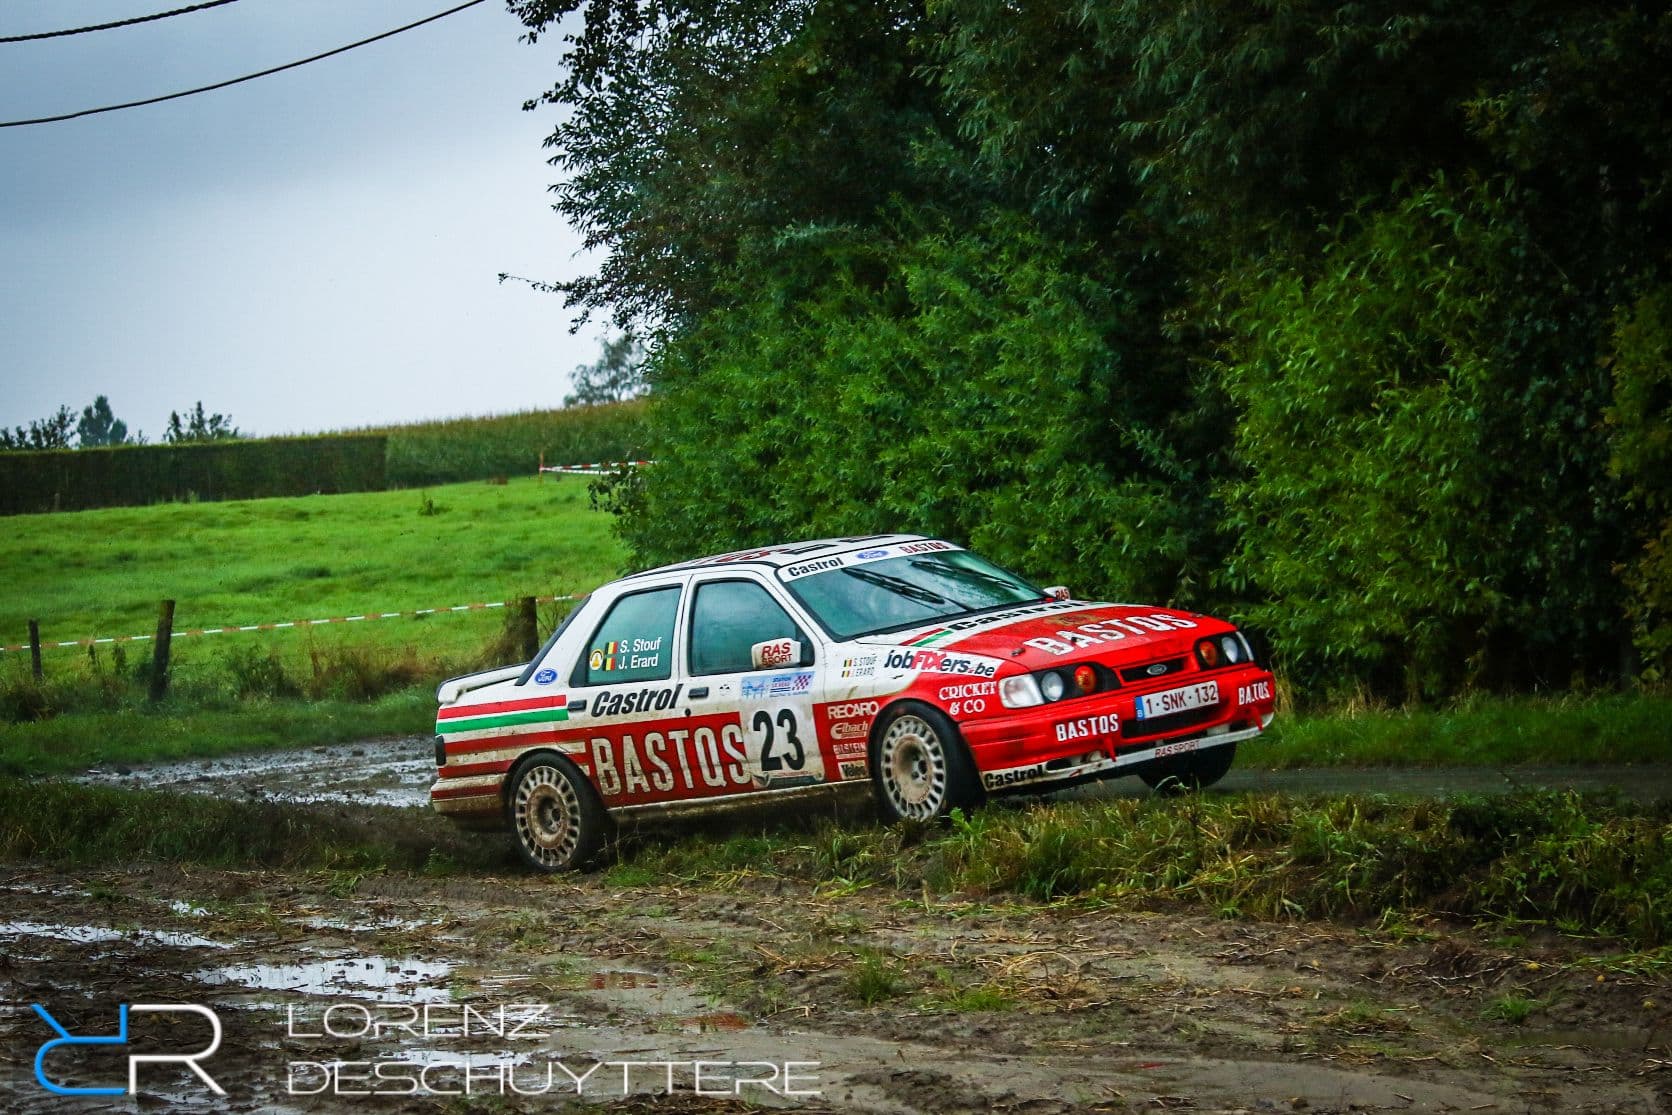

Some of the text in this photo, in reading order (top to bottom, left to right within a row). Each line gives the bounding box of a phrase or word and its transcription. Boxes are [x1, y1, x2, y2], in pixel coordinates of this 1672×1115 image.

[899, 542, 950, 554] BASTOS
[787, 557, 844, 577] Castrol
[947, 601, 1086, 631] Castrol
[620, 637, 661, 653] S. Stouf
[1023, 613, 1198, 656] BASTOS
[762, 642, 791, 656] RAS
[619, 653, 659, 669] J. Erard
[884, 650, 995, 677] jobFIXers.be
[591, 684, 683, 717] Castrol
[939, 681, 997, 700] CRICKET
[827, 701, 880, 719] RECARO
[949, 699, 985, 715] & CO
[1056, 713, 1119, 742] BASTOS
[752, 708, 805, 772] 23
[591, 724, 752, 796] BASTOS
[984, 764, 1044, 789] Castrol
